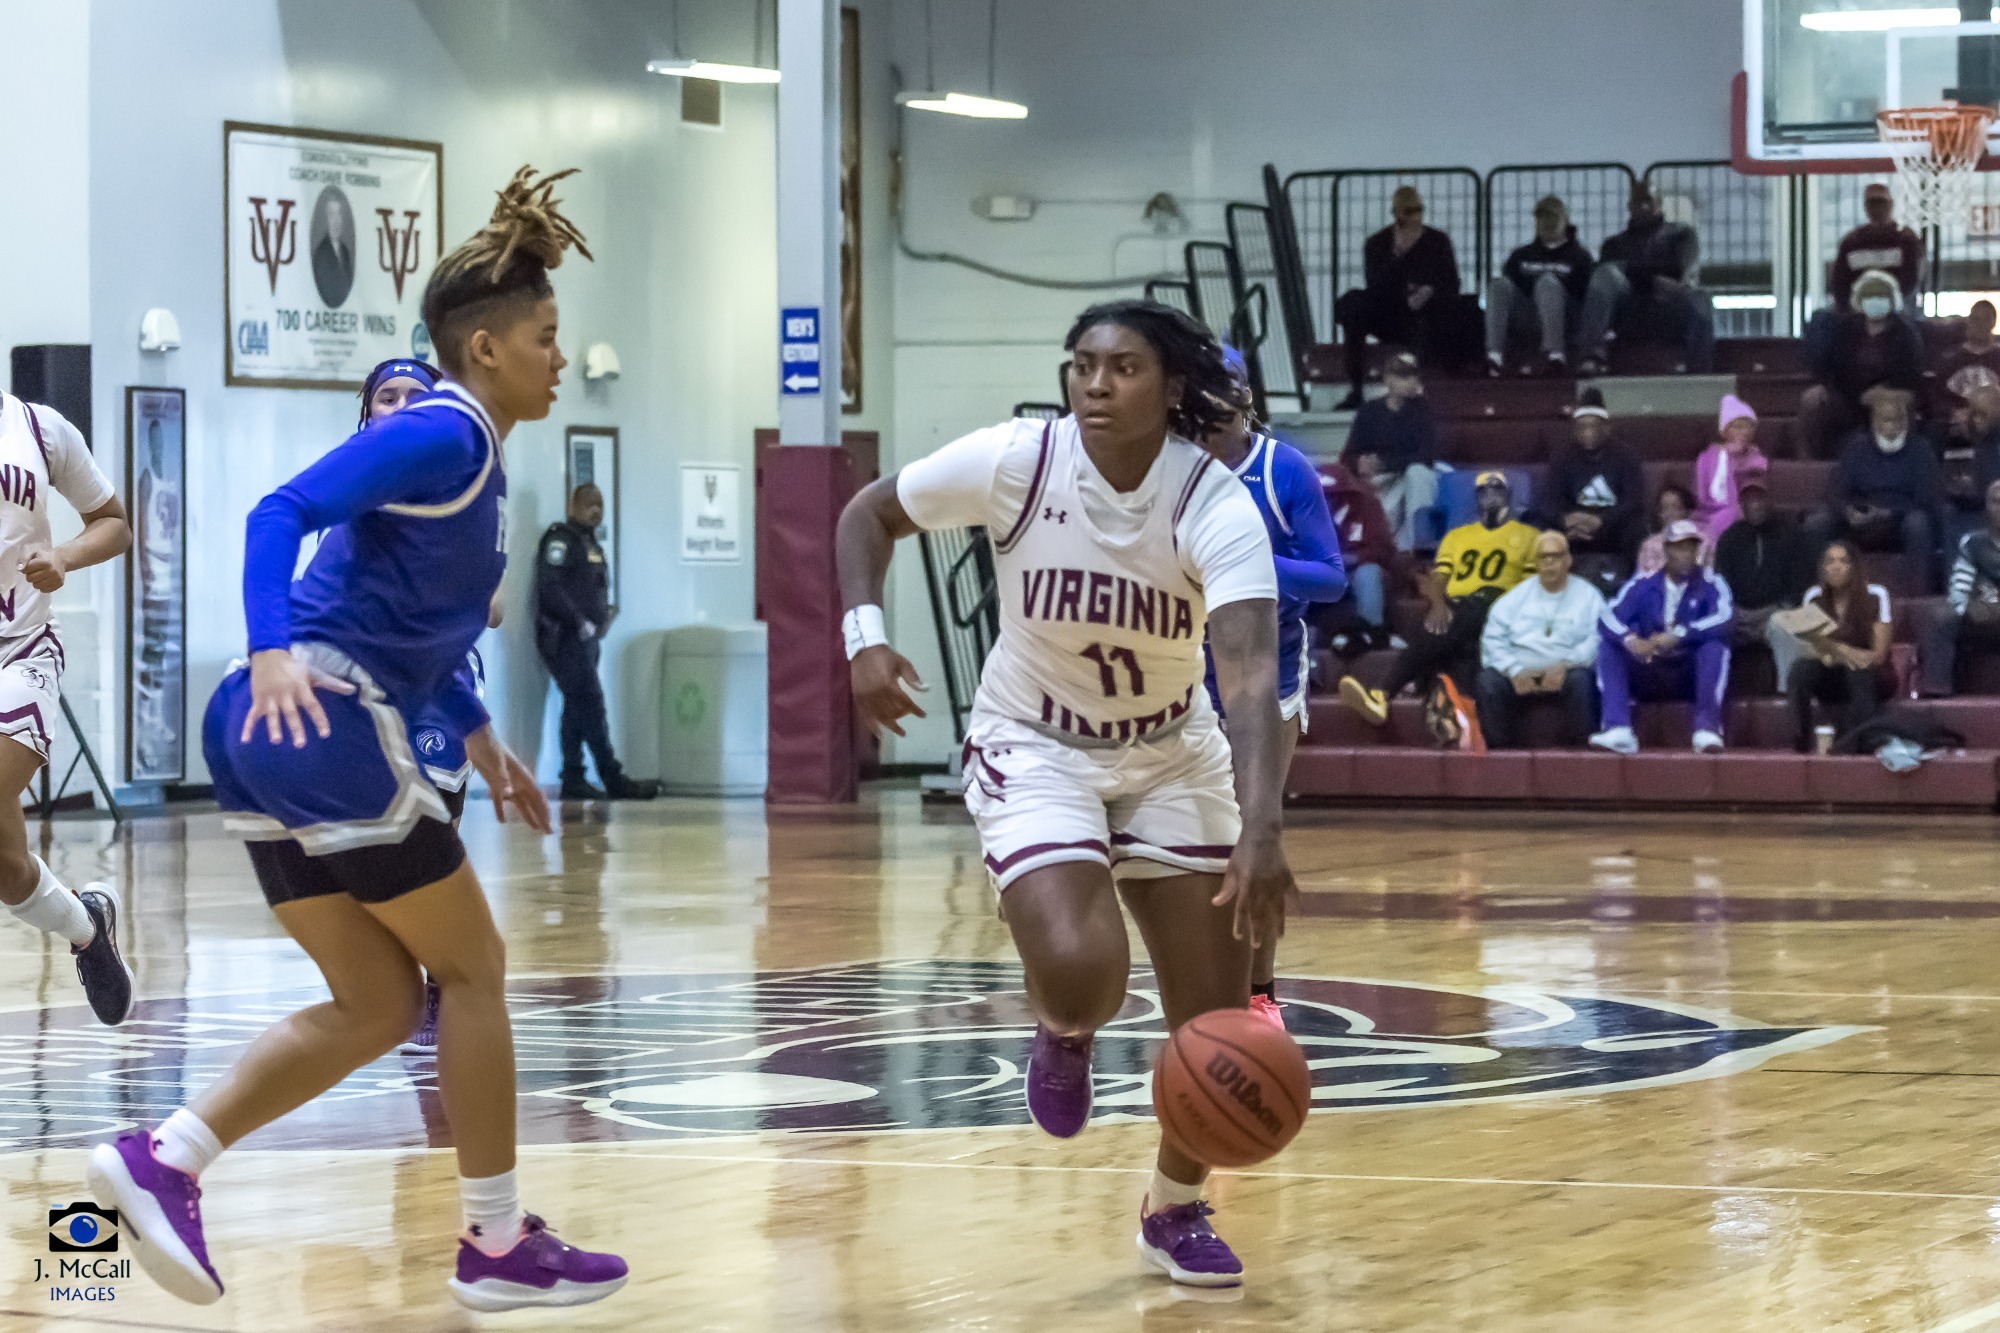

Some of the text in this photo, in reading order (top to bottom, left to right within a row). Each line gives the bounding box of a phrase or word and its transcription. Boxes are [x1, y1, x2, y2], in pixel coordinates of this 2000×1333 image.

[276, 308, 396, 336] 700 CAREER WINS
[1456, 548, 1507, 582] 90
[1022, 568, 1194, 640] VIRGINIA
[1078, 642, 1146, 697] 11
